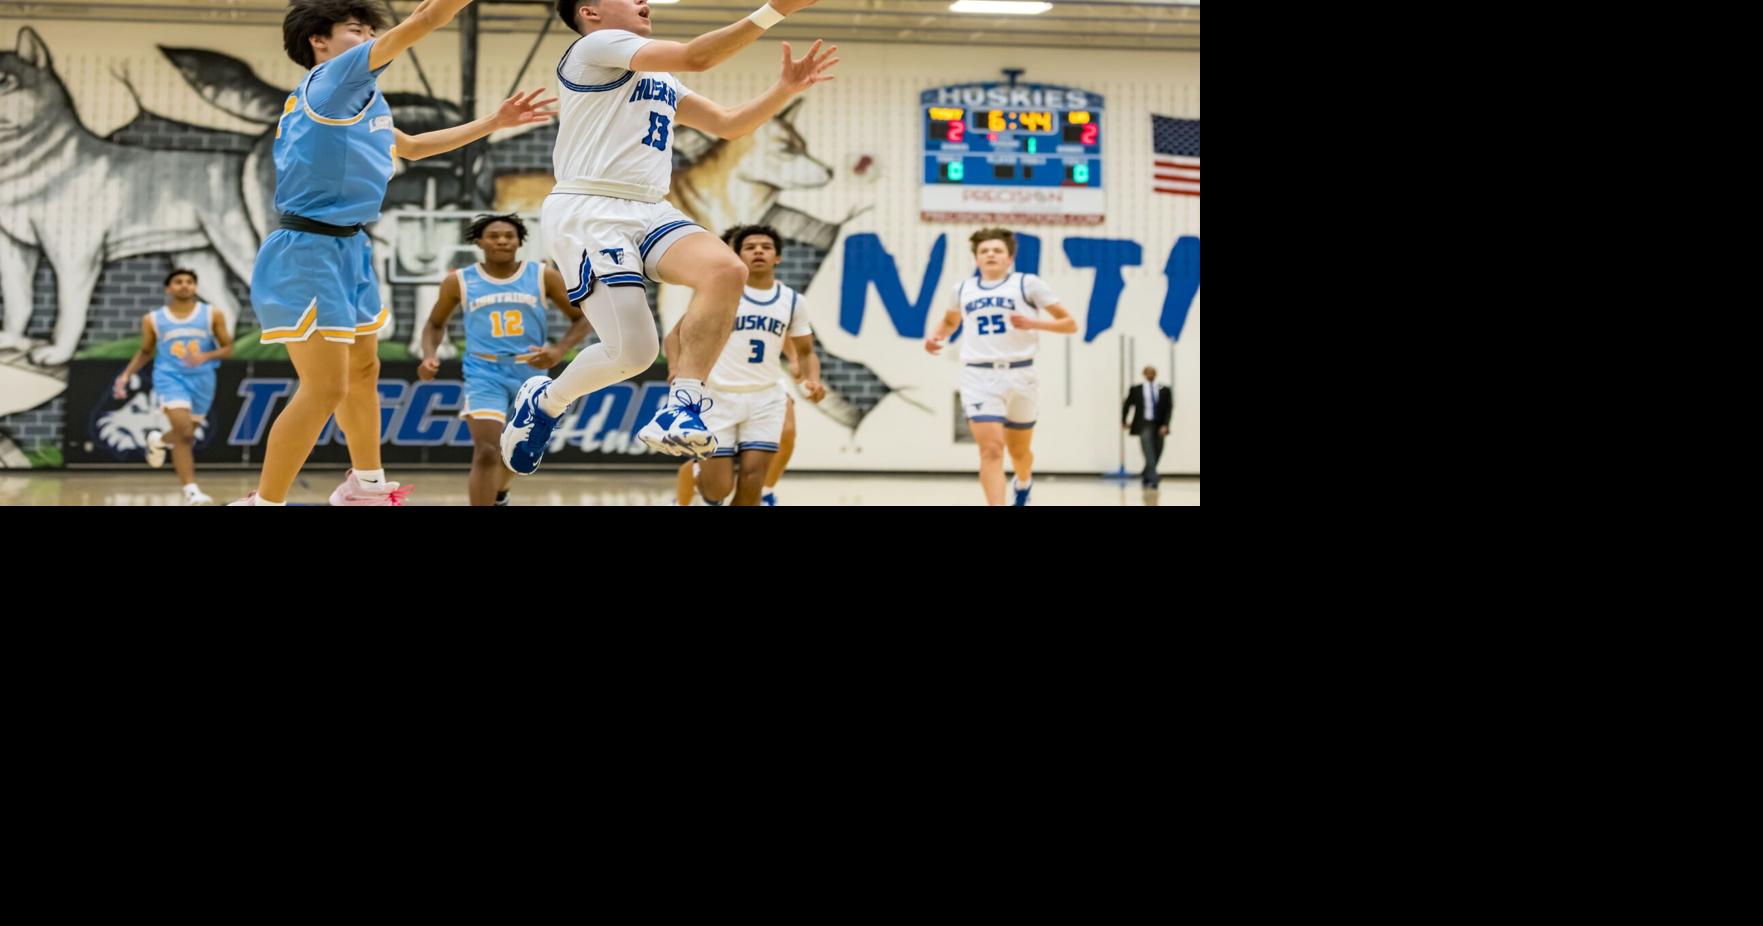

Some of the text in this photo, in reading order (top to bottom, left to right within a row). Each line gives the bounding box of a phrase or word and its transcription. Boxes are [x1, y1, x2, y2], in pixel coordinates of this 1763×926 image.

[938, 86, 1089, 109] HUSKIES
[641, 110, 671, 152] 13
[947, 120, 966, 143] 2
[988, 110, 1052, 132] 6:44
[1080, 123, 1098, 145] 2
[965, 296, 1016, 314] HUSKIES
[490, 310, 524, 337] 12
[735, 315, 786, 337] USKIES
[977, 315, 1006, 335] 25
[748, 339, 765, 364] 3
